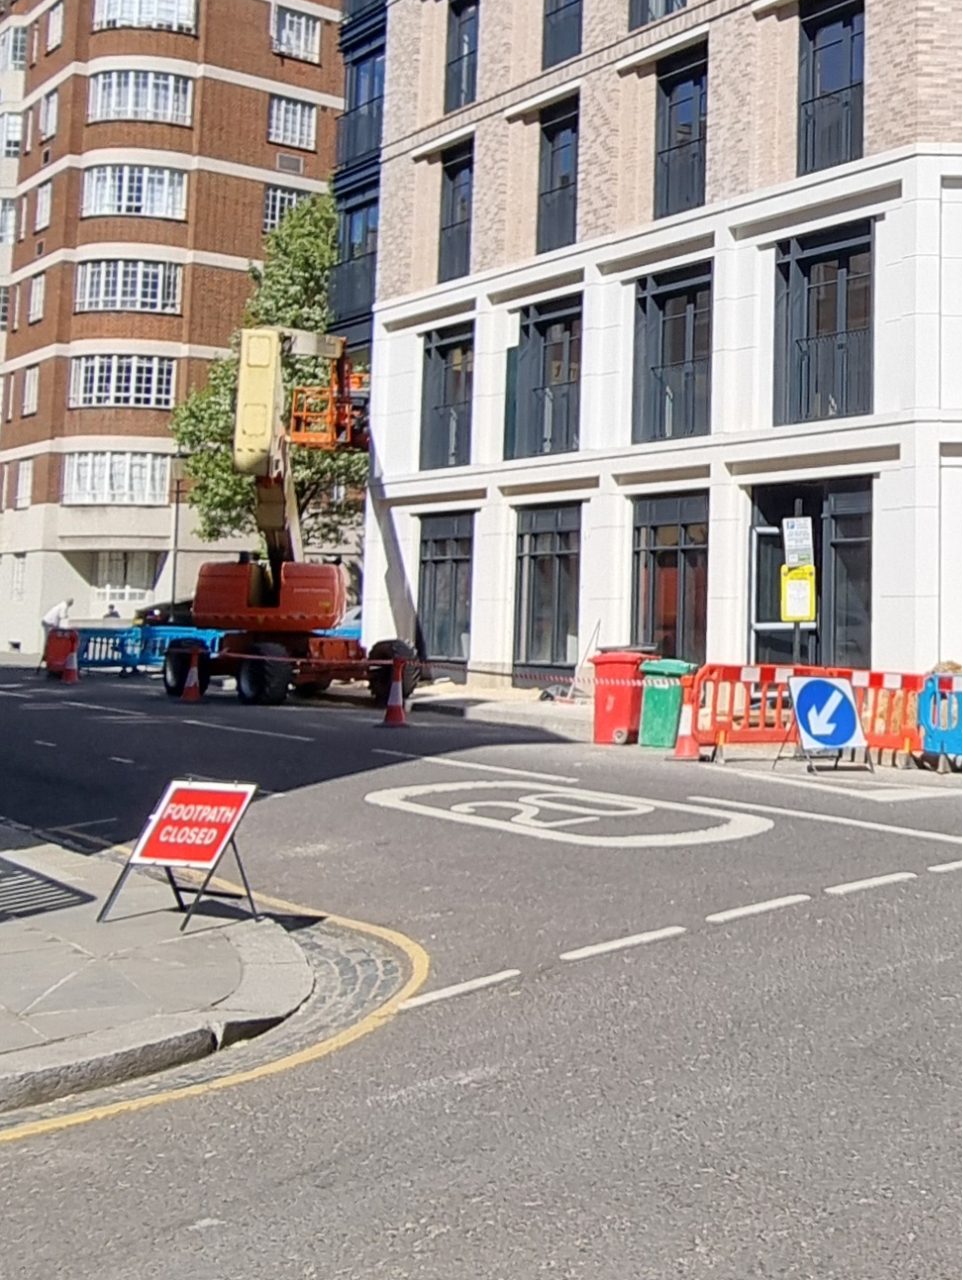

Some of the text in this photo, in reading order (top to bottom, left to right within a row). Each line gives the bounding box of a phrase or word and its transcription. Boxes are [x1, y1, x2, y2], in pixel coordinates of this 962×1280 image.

[163, 803, 237, 824] FOOTPATH
[450, 793, 656, 828] 20
[159, 825, 218, 845] CLOSED
